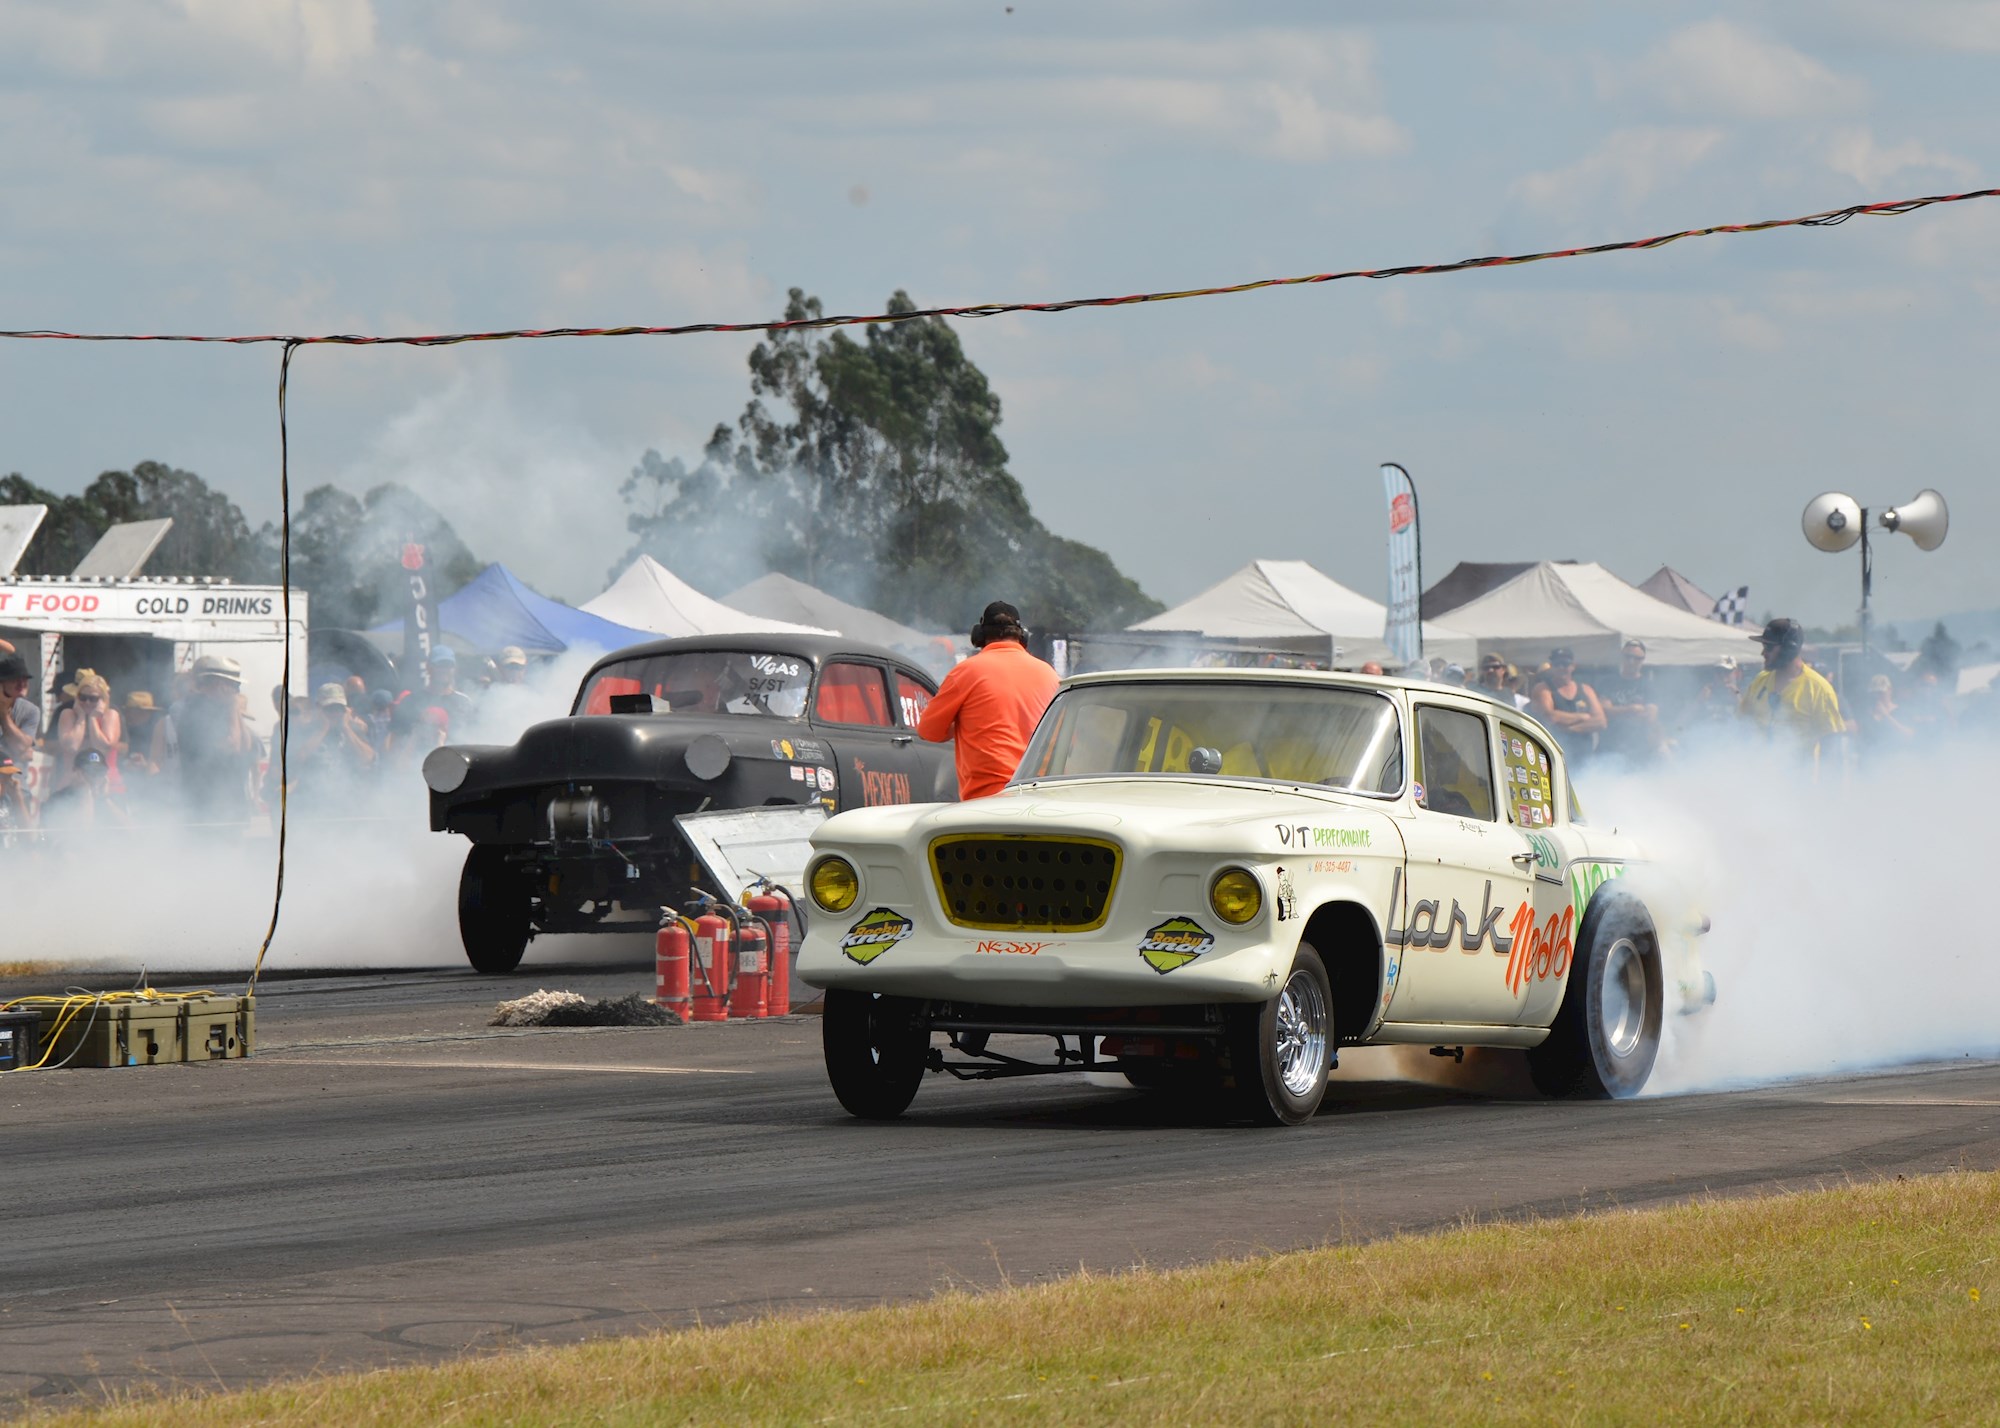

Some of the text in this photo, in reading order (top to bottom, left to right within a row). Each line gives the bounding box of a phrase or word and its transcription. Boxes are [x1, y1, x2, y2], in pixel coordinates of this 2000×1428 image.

[26, 594, 99, 612] FOOD
[136, 597, 272, 615] COLD DRINKS
[749, 677, 785, 693] S/ST
[742, 692, 769, 707] 271
[1313, 827, 1372, 848] PERFORMANCE
[1385, 866, 1513, 955] Lark
